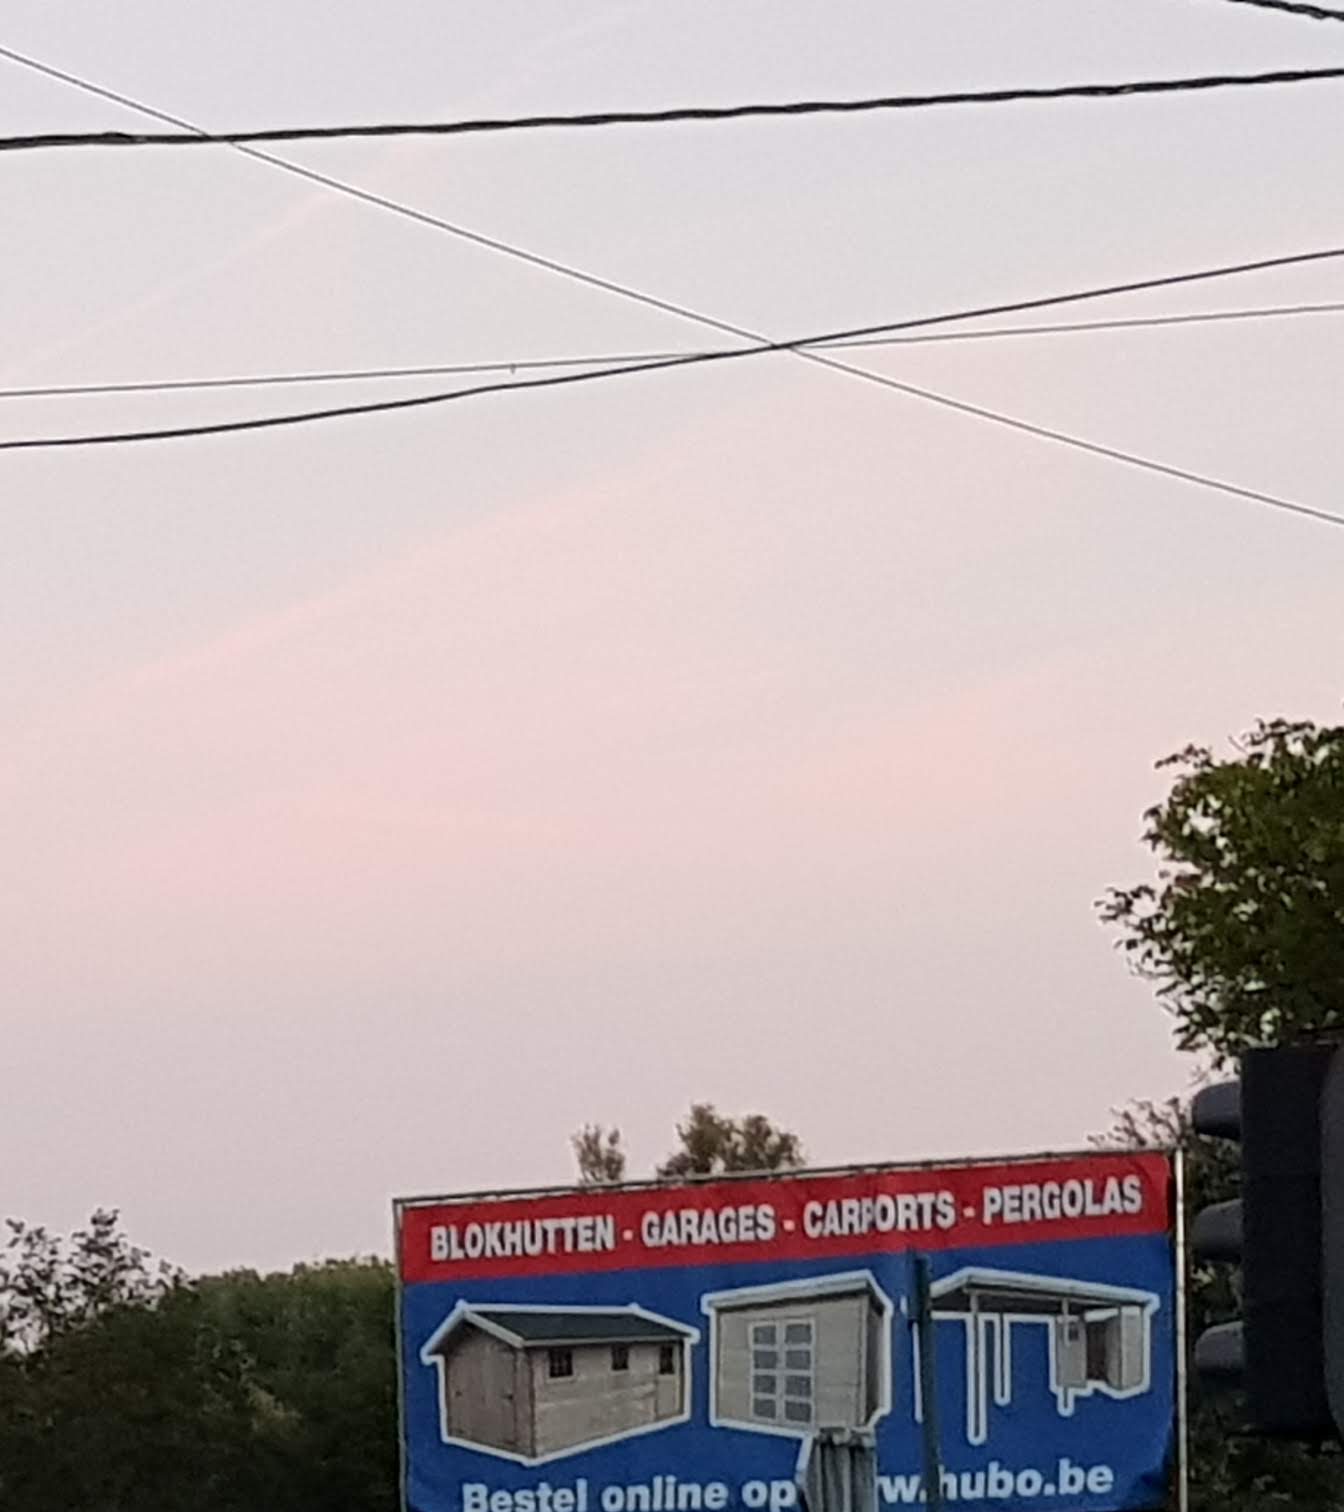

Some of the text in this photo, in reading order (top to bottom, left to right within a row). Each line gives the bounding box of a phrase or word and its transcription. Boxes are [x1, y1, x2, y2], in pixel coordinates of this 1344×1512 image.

[430, 1215, 615, 1261] BLOKHUTTEN
[640, 1204, 776, 1247] GARAGES
[803, 1190, 956, 1239] CARPORTS
[982, 1174, 1143, 1225] PERGOLAS
[876, 1458, 1114, 1504] w.hubo.be
